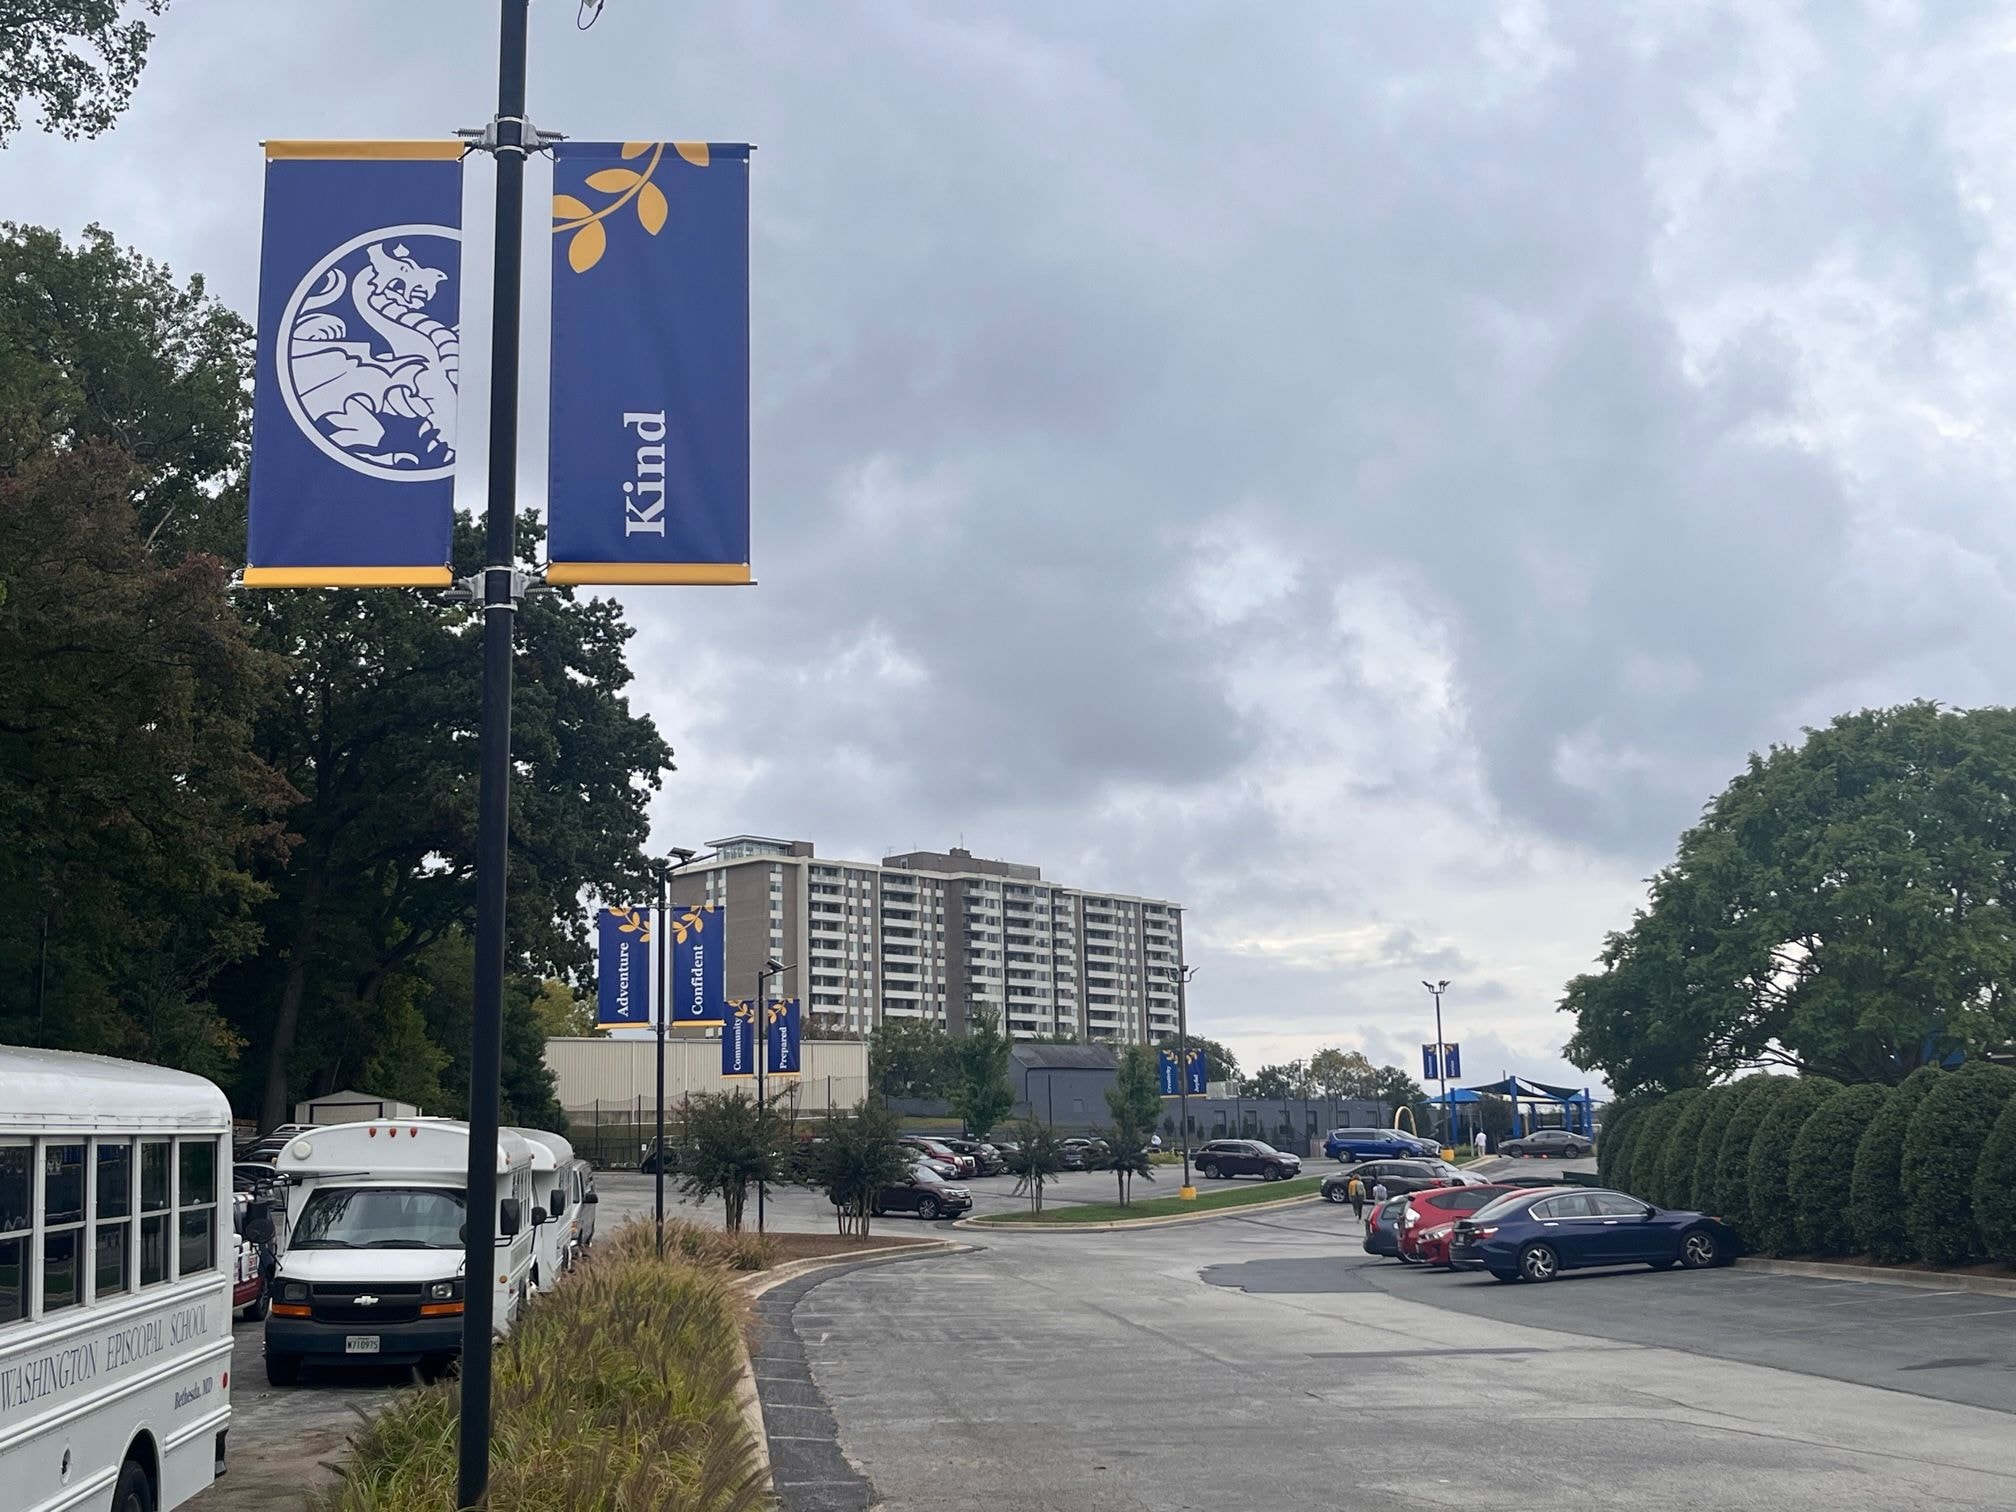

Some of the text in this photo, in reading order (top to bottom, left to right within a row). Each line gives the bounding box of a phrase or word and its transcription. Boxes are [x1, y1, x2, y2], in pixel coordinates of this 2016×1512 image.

[623, 410, 666, 537] Kind
[616, 942, 629, 1017] Adventure
[691, 945, 704, 1015] Confident
[733, 1017, 743, 1071] Community
[779, 1026, 787, 1069] Prepared
[0, 1304, 208, 1412] WASHINGTON EPISCOPAL SCHOOL
[202, 1376, 213, 1396] MD
